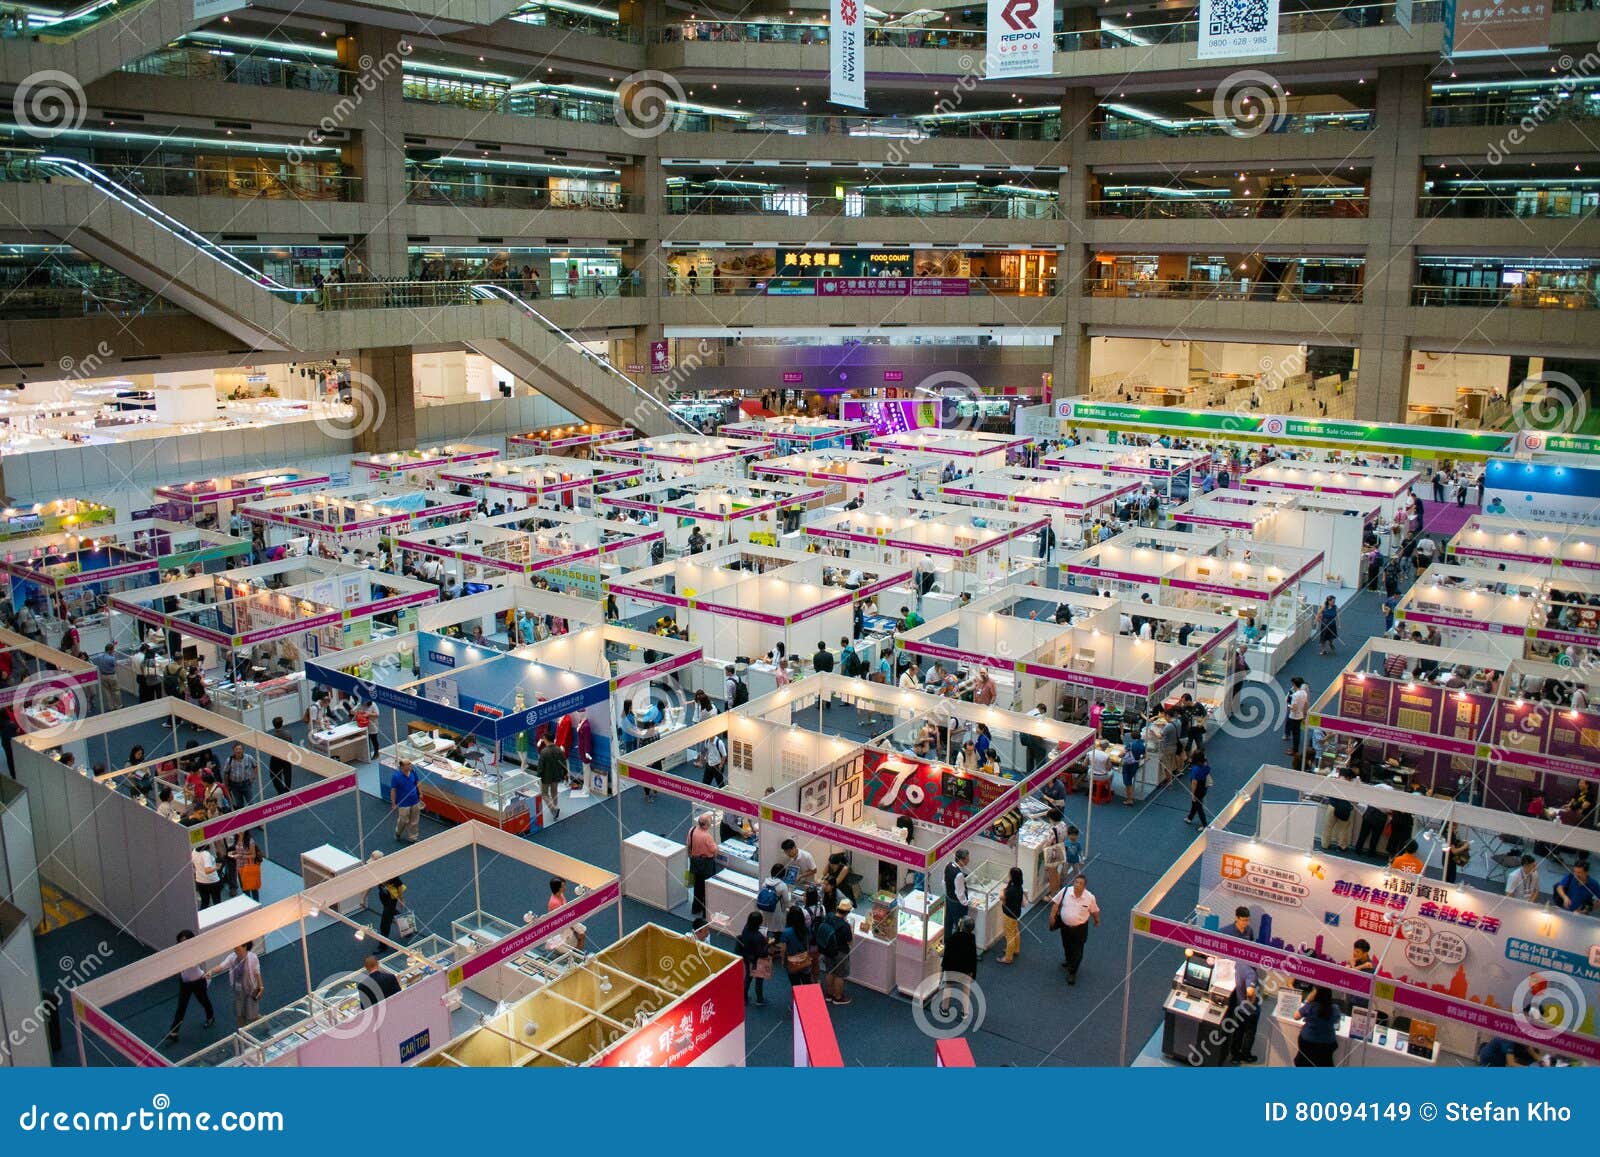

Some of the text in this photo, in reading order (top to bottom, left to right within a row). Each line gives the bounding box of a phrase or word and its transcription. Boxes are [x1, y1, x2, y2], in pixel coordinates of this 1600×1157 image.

[1001, 32, 1041, 41] REPON
[847, 31, 855, 82] TAIWAN
[870, 254, 910, 262] FOOD COURT
[1119, 411, 1141, 419] Counter
[1326, 428, 1339, 436] Sale
[1529, 508, 1546, 516] IBM
[1384, 877, 1449, 904] 精誠資訊
[1332, 879, 1410, 911] 創新智慧
[1418, 901, 1502, 934] 金融生活
[501, 910, 576, 954] CARTOR SECURITY PRINTING
[695, 1026, 713, 1043] Plant
